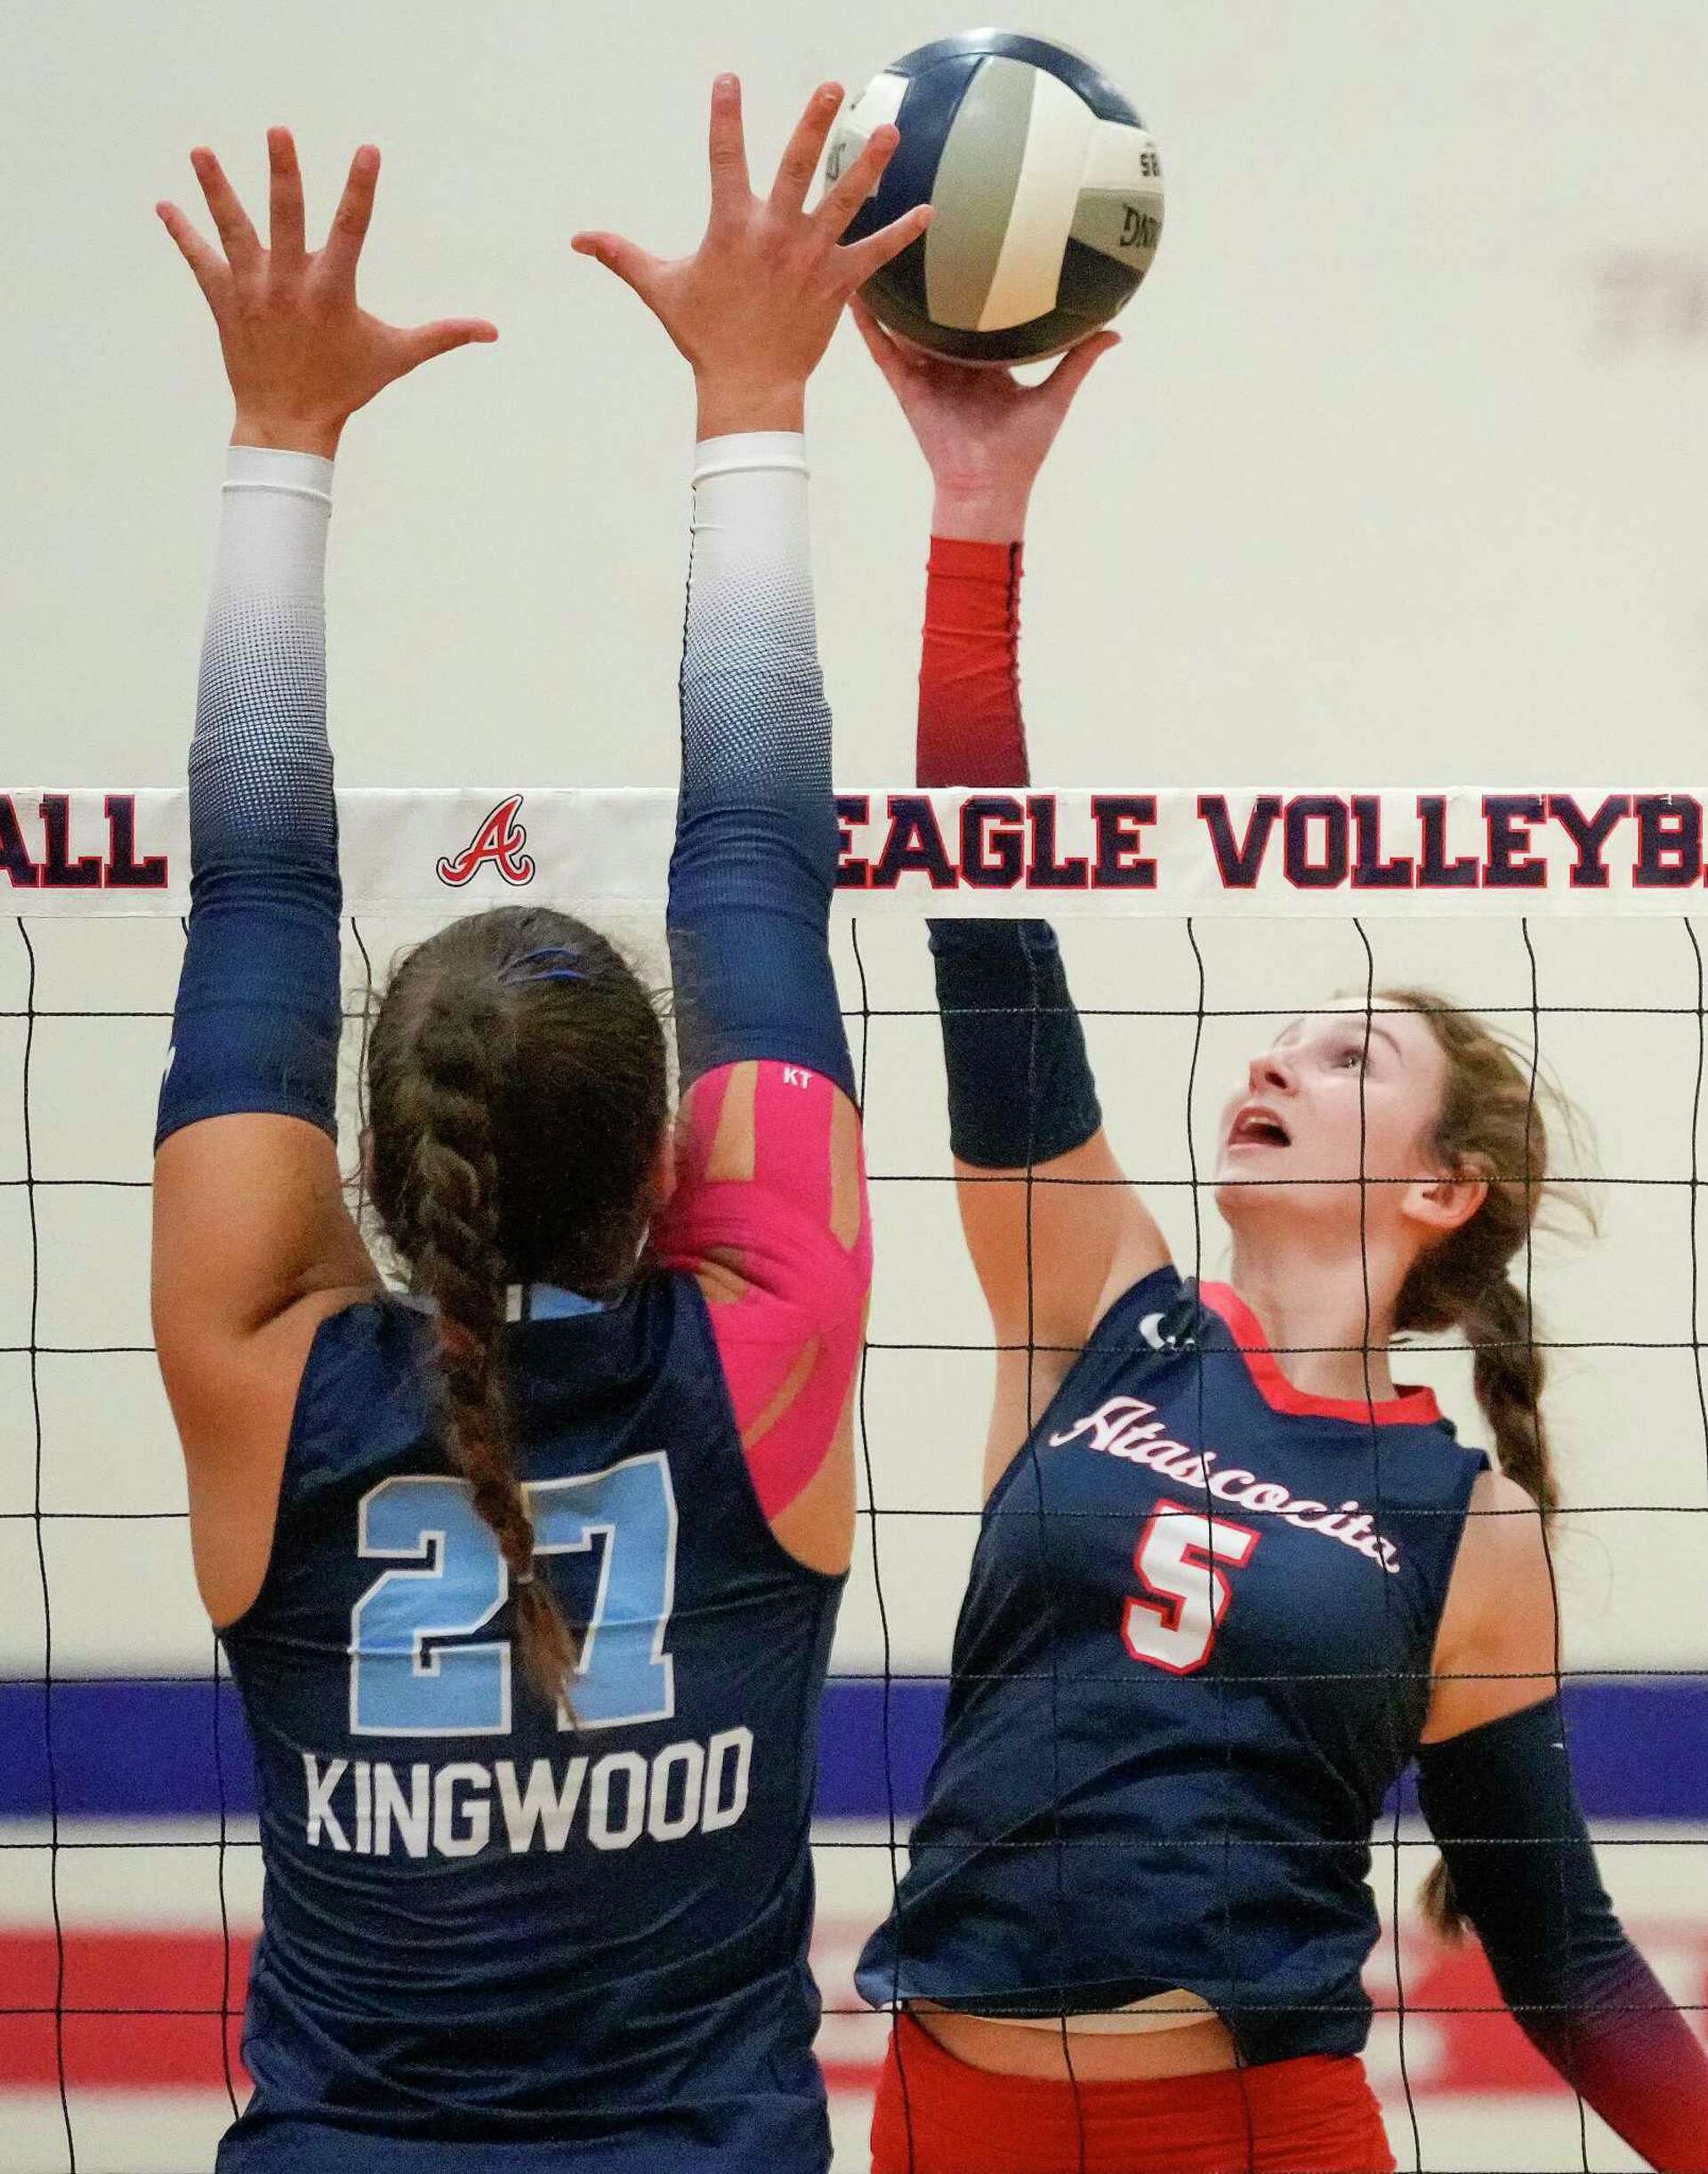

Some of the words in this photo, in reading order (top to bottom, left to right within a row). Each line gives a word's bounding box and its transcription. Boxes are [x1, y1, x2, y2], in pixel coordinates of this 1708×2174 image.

[436, 793, 536, 887] A
[1197, 794, 1708, 889] VOLLEYB
[784, 1067, 812, 1090] KT
[1048, 1394, 1401, 1574] Atascocita
[348, 1449, 679, 1737] 27
[1119, 1497, 1262, 1677] 5
[302, 1726, 754, 1858] KINGWOOD
